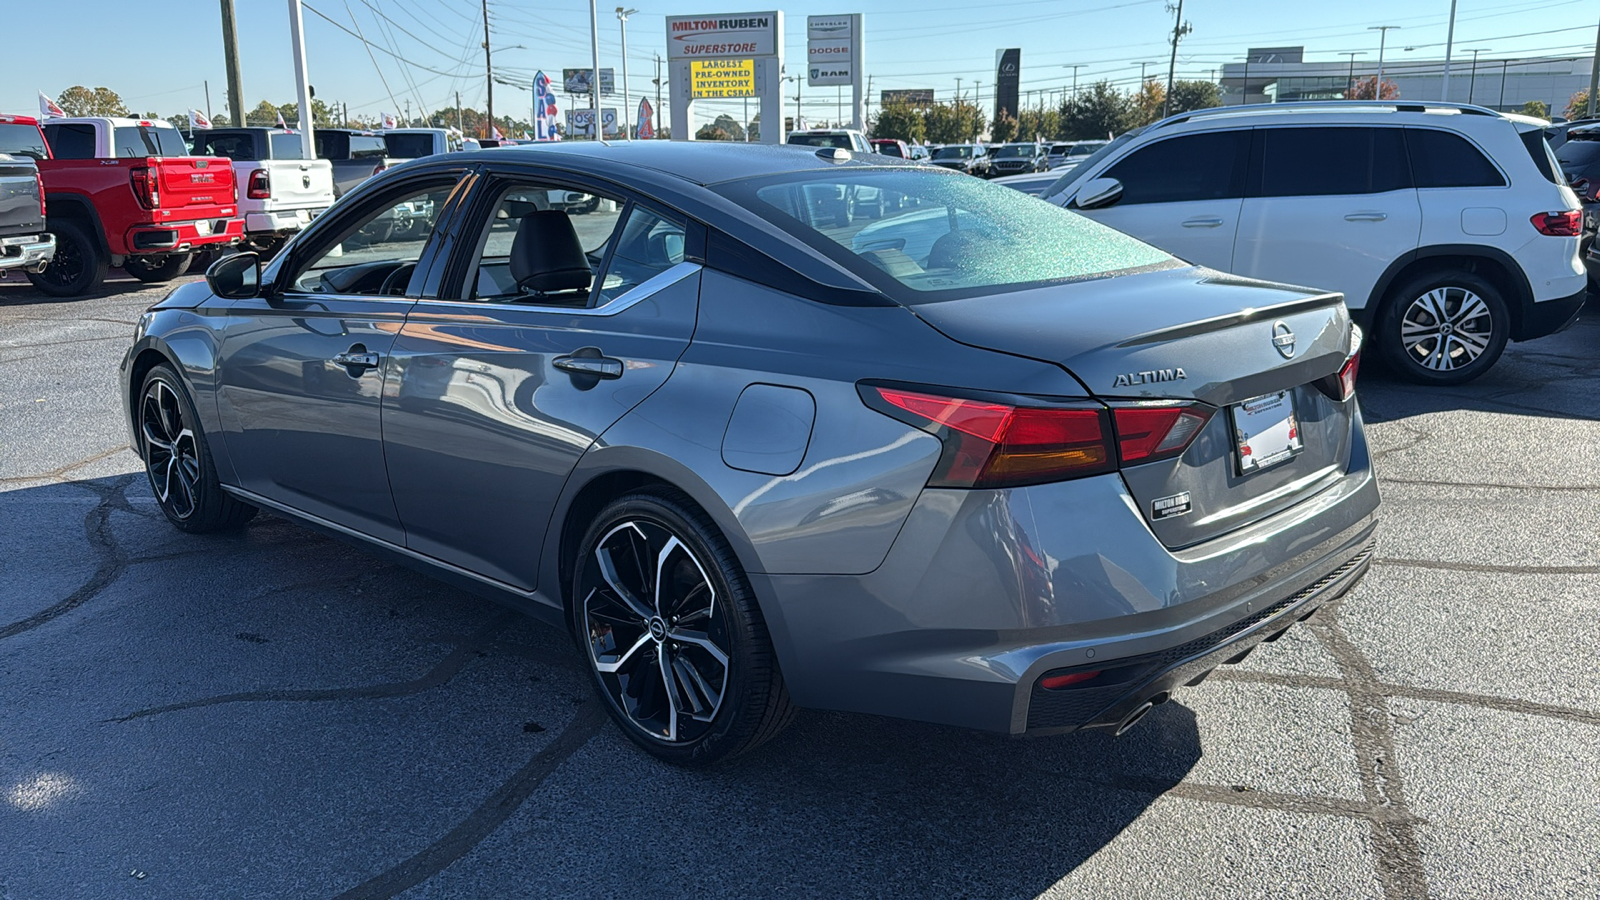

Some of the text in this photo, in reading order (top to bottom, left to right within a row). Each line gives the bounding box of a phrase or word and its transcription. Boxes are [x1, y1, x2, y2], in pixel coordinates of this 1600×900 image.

[672, 18, 768, 31] MILTON RUBEN
[683, 42, 757, 54] SUPERSTORE
[702, 60, 743, 68] LARGEST
[695, 70, 750, 78] PRE-OWNED
[696, 79, 750, 88] INVENTORY
[726, 89, 754, 97] CSRA!
[567, 113, 614, 124] HOSTLO
[1112, 367, 1188, 388] ALTIMA
